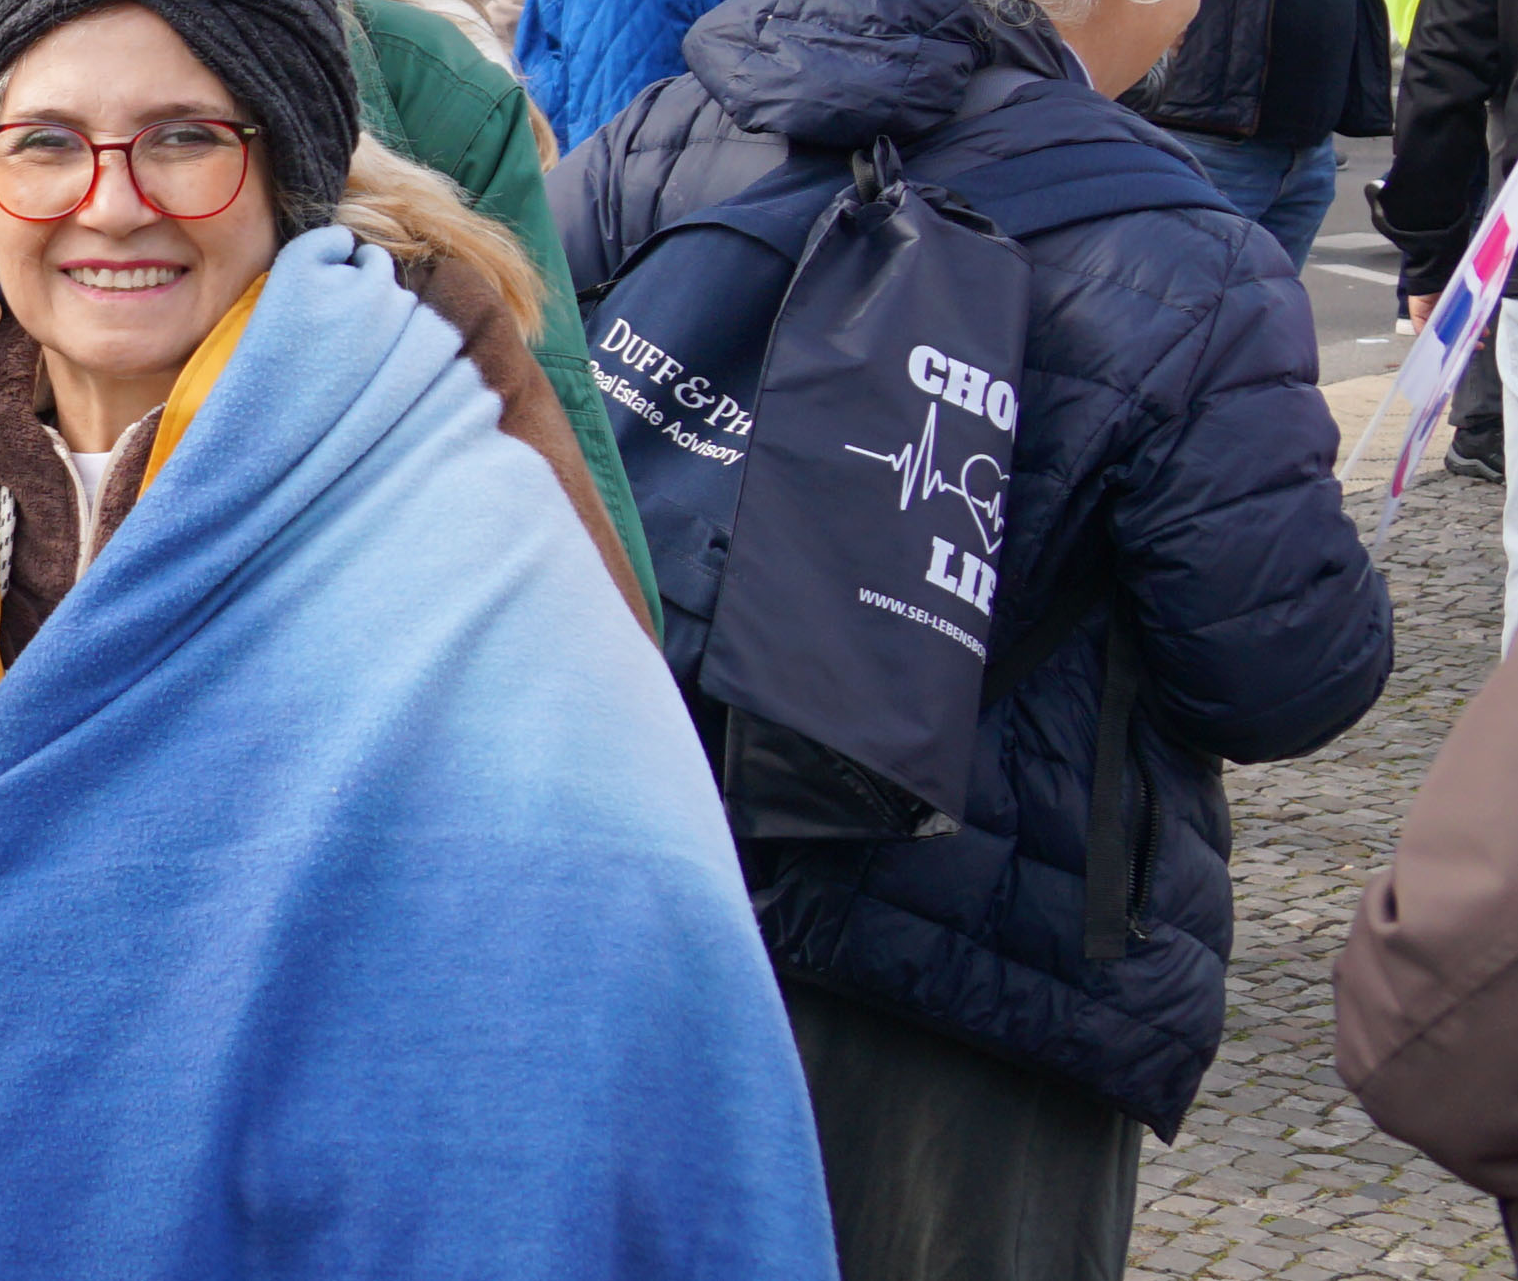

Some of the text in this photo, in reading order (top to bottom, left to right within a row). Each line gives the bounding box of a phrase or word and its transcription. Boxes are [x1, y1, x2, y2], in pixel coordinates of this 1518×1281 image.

[600, 318, 753, 436] DUFF & PH
[612, 376, 664, 426] Estate
[662, 420, 745, 466] Advisory
[908, 345, 1018, 444] CHO
[925, 535, 997, 618] LIF
[858, 587, 987, 664] WWW.SEI-LEBENSBO
